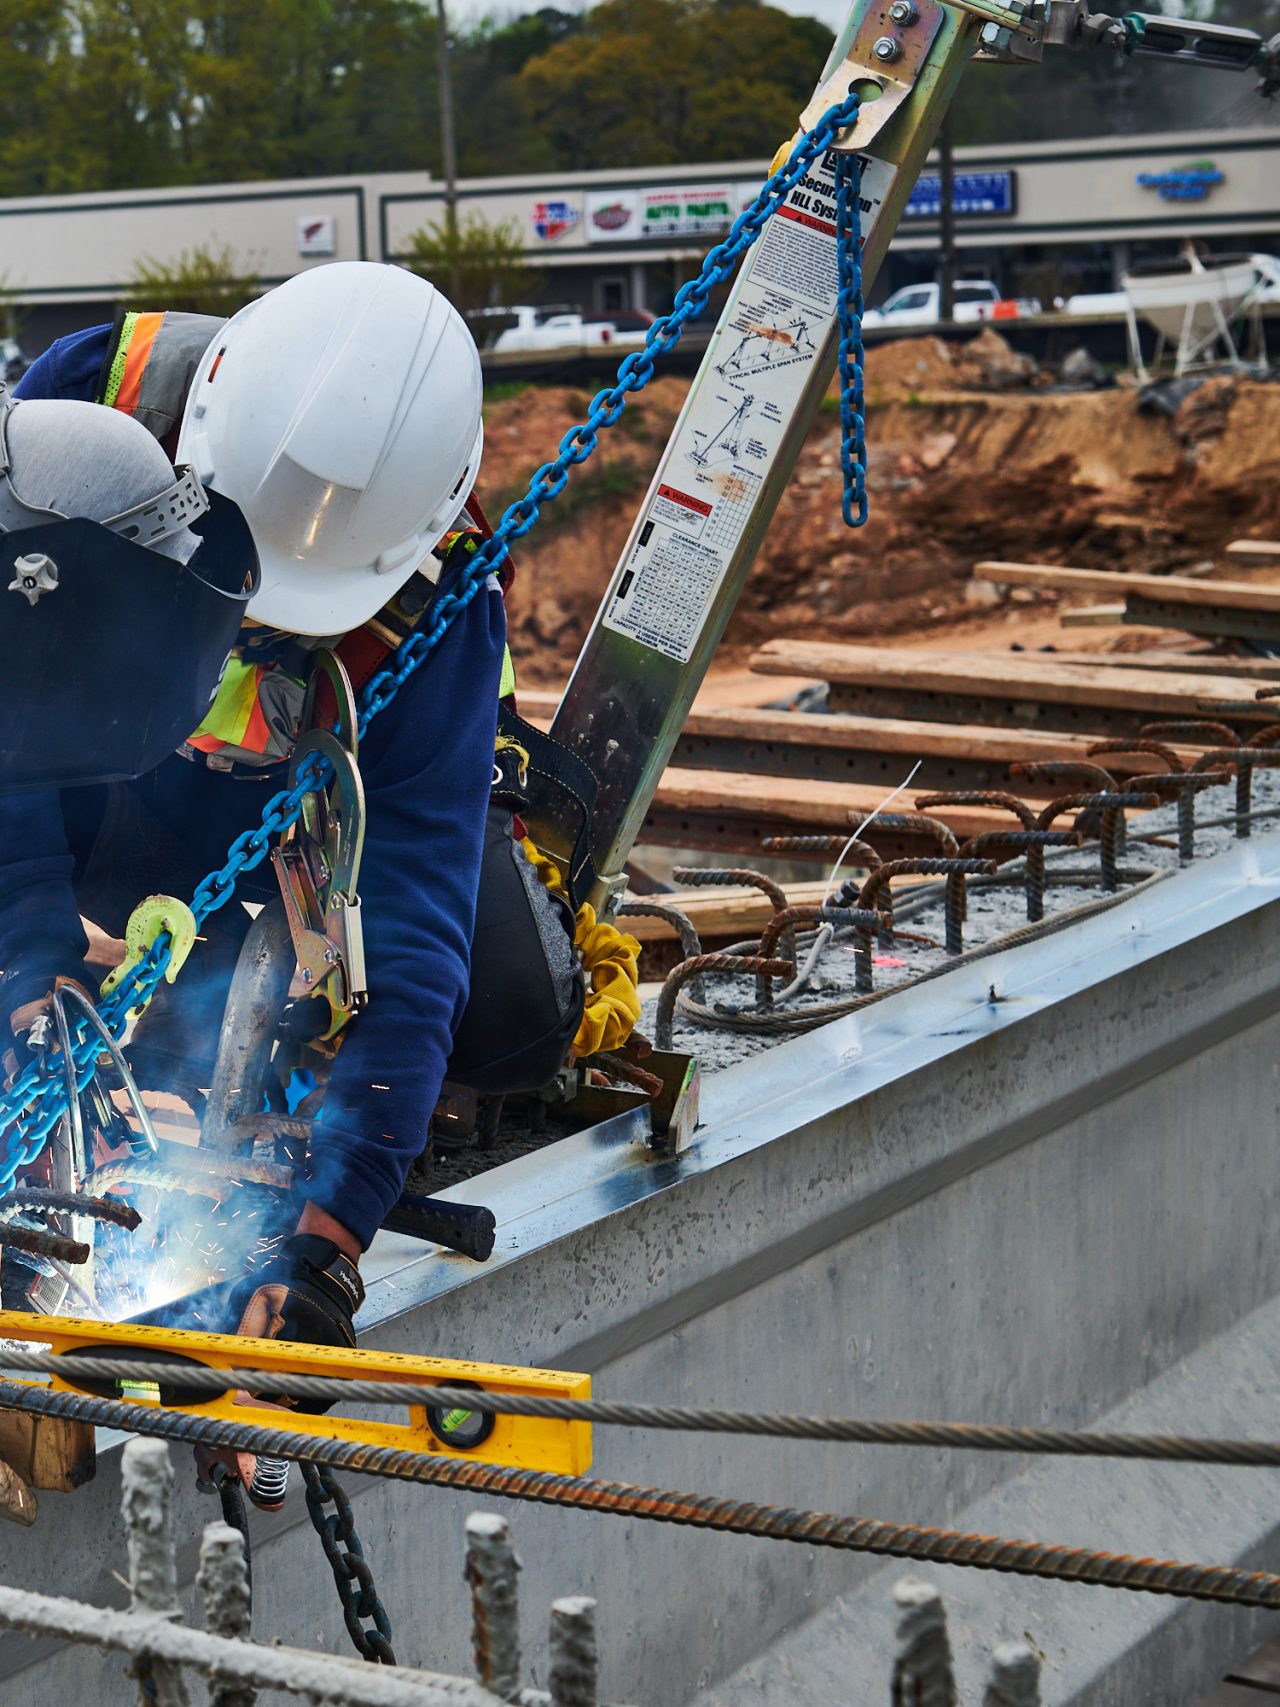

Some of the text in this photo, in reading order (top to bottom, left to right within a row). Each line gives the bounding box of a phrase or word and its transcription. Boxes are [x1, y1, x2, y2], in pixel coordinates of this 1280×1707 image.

[790, 191, 837, 221] HLL Syst
[805, 219, 837, 236] WARNIN
[729, 372, 750, 380] TYPICAL
[751, 364, 775, 374] MULTIPLE
[792, 354, 813, 363] SYSTEM
[672, 492, 709, 513] WARNING
[672, 532, 718, 556] CLEARANCE CHART
[642, 632, 658, 642] USERS
[669, 644, 682, 653] SPAN
